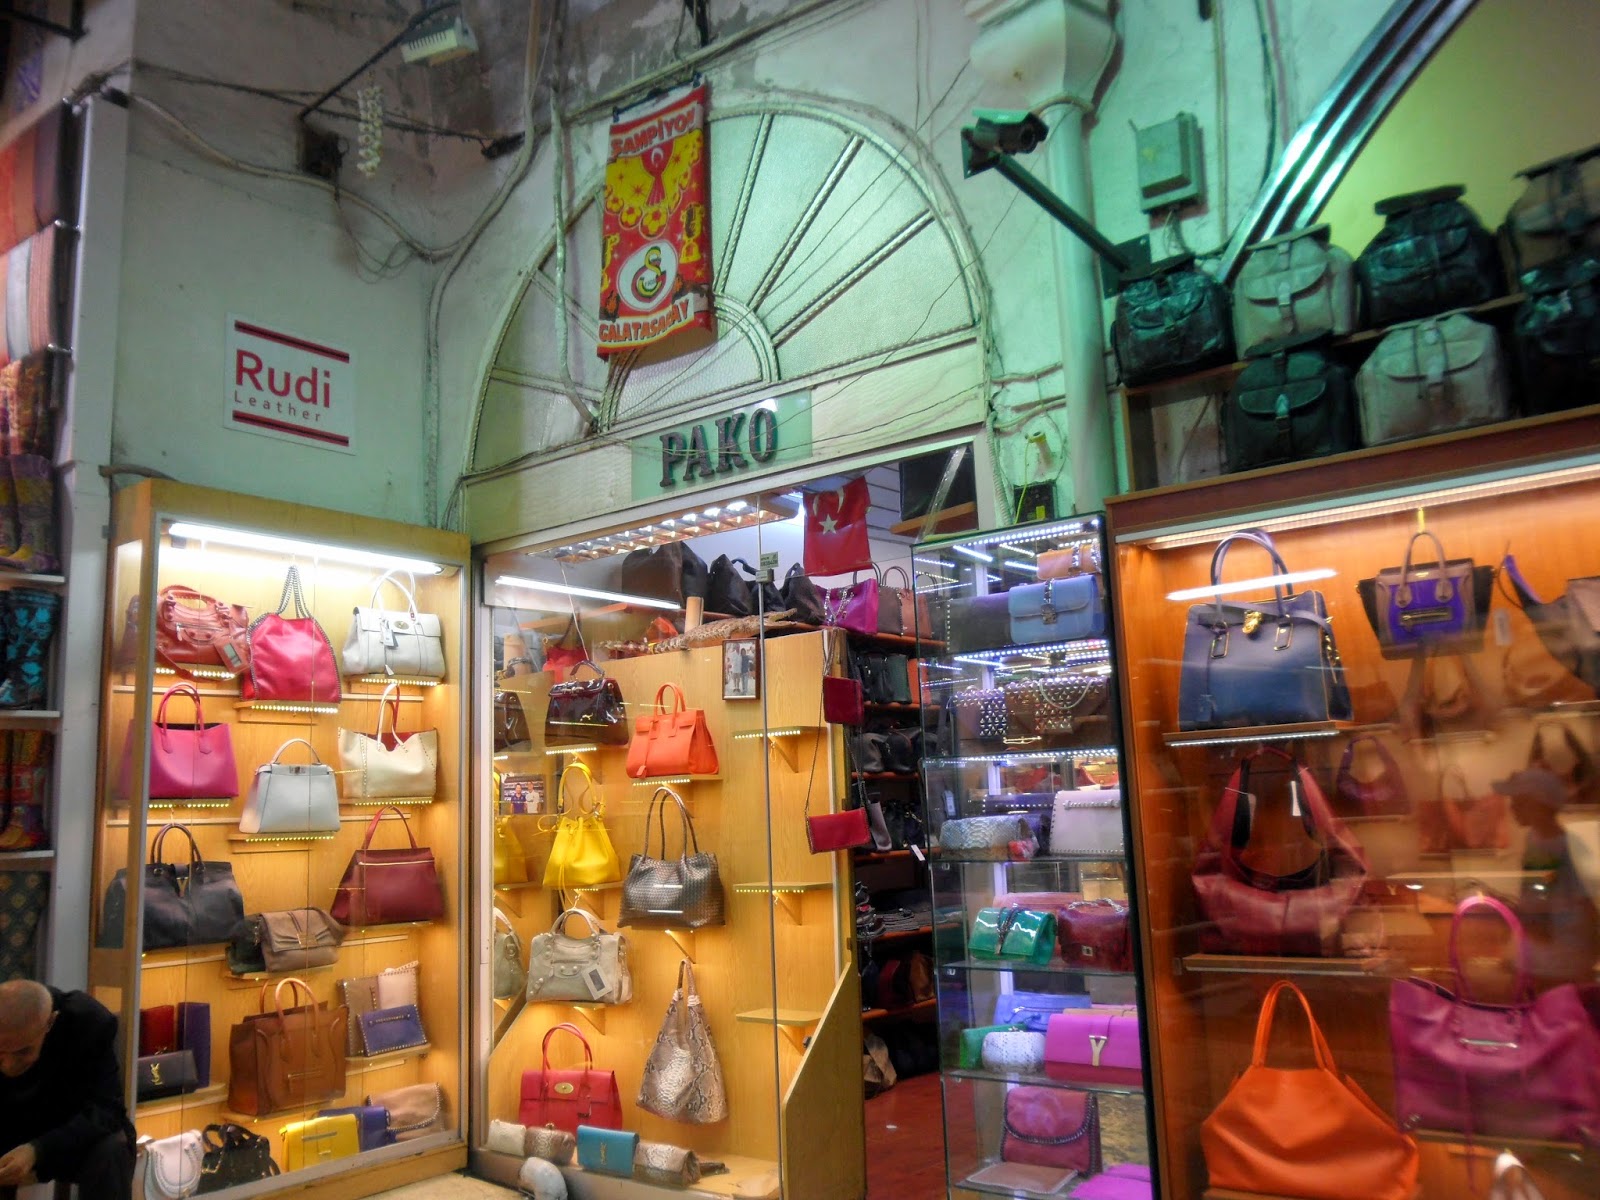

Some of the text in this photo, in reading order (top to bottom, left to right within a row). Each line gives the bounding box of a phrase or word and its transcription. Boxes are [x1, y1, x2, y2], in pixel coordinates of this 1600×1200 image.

[599, 298, 690, 343] GALATASARAY
[235, 348, 331, 408] Rudi
[233, 389, 322, 422] Leather
[659, 407, 778, 488] PAKO
